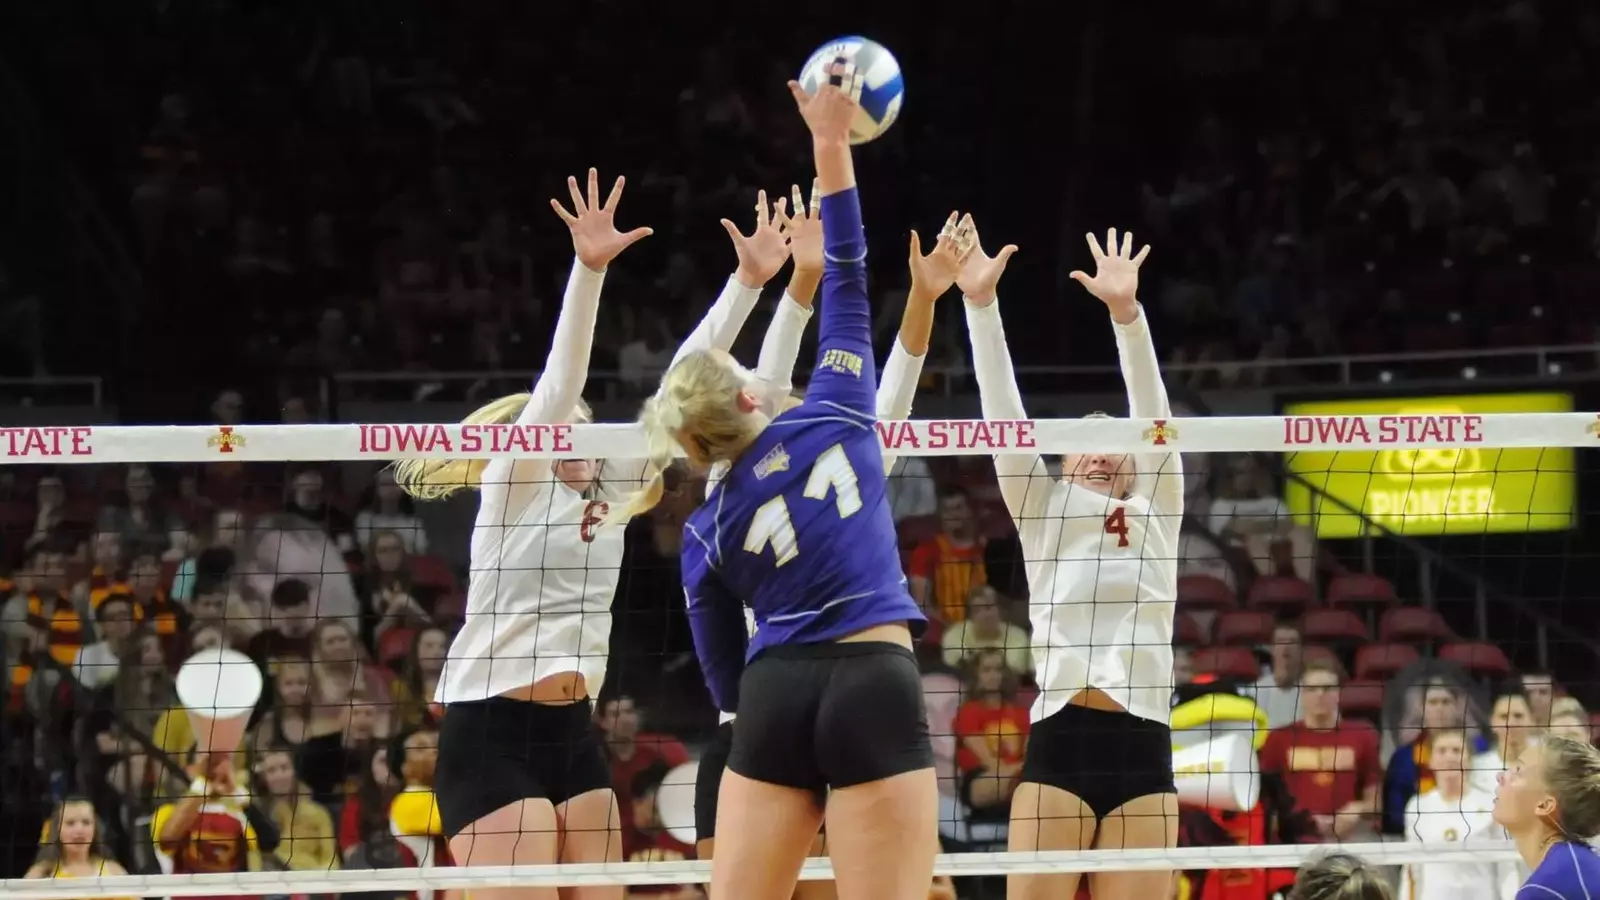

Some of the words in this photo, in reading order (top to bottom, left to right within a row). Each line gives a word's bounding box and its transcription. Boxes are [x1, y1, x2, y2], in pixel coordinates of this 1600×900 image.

[359, 425, 453, 452] IOWA
[460, 425, 573, 452] STATE
[928, 421, 1036, 448] STATE
[1284, 416, 1371, 444] IOWA
[1379, 416, 1483, 443] STATE
[1104, 507, 1129, 547] 4
